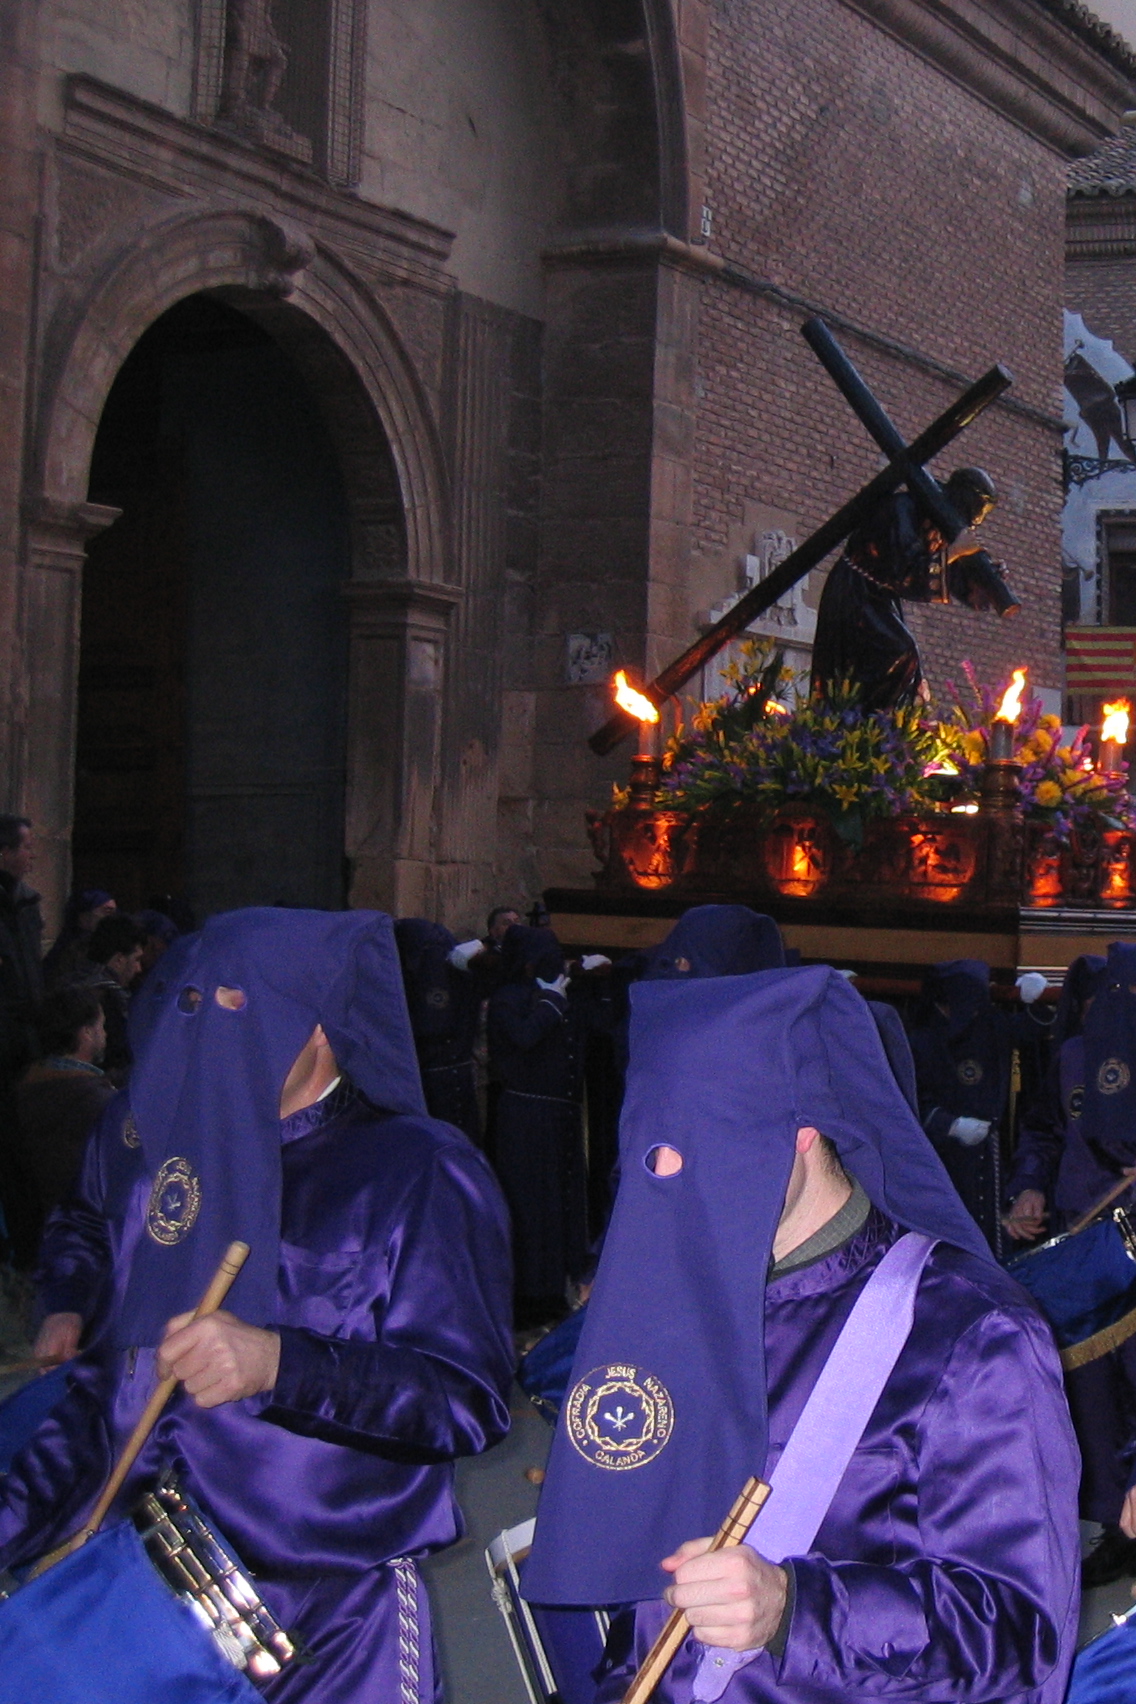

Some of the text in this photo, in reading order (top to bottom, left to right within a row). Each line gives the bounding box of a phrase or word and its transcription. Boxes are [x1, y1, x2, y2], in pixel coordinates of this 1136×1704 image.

[605, 1366, 636, 1379] JESUS
[643, 1376, 668, 1438] NAZARENO
[595, 1450, 646, 1466] CALANDA
